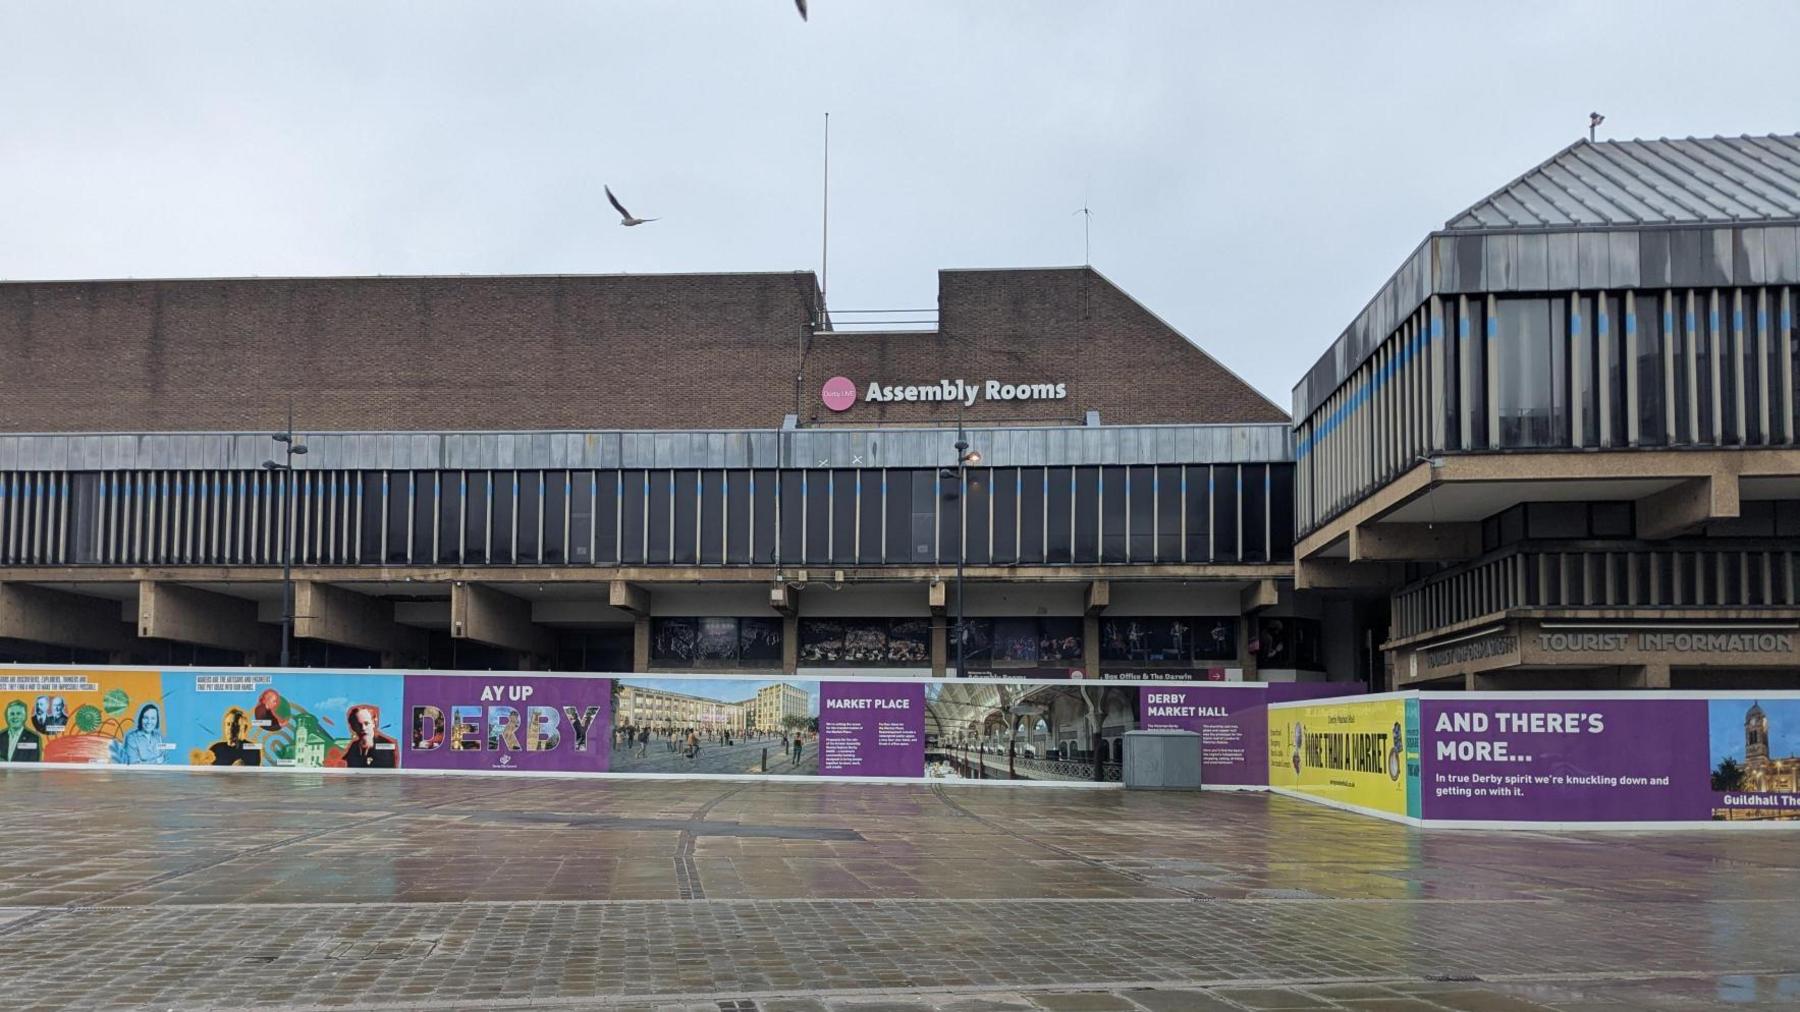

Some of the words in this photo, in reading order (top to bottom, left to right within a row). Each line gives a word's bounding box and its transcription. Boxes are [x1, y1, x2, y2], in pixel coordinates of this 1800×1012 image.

[865, 379, 979, 406] Assembly
[985, 379, 1067, 400] Rooms
[1539, 634, 1628, 651] TOURIST
[1638, 634, 1793, 652] INFORMATION
[480, 686, 505, 701] AY
[509, 686, 533, 701] UP
[1147, 694, 1186, 704] DERBY
[826, 699, 872, 709] MARKET
[874, 699, 910, 709] PLACE
[1147, 706, 1196, 717] MARKET
[1198, 706, 1229, 717] HALL
[411, 705, 601, 751] DERBY
[1435, 712, 1489, 732] AND
[1495, 713, 1605, 733] THERE'S
[1305, 733, 1323, 768] MORE
[1324, 733, 1343, 770] THAN
[1345, 733, 1351, 771] A
[1352, 733, 1387, 775] MARKET
[1436, 741, 1533, 762] MORE...
[1436, 773, 1446, 782] In
[1448, 774, 1470, 783] true
[1472, 774, 1503, 785] Derby
[1505, 774, 1532, 785] spirit
[1534, 775, 1564, 784] we're
[1566, 775, 1618, 787] knuckling
[1619, 776, 1648, 785] down
[1649, 776, 1670, 786] and
[1436, 786, 1472, 798] getting
[1474, 788, 1487, 796] on
[1489, 787, 1512, 796] with
[1513, 787, 1525, 797] it.
[1723, 794, 1779, 806] Guildhall
